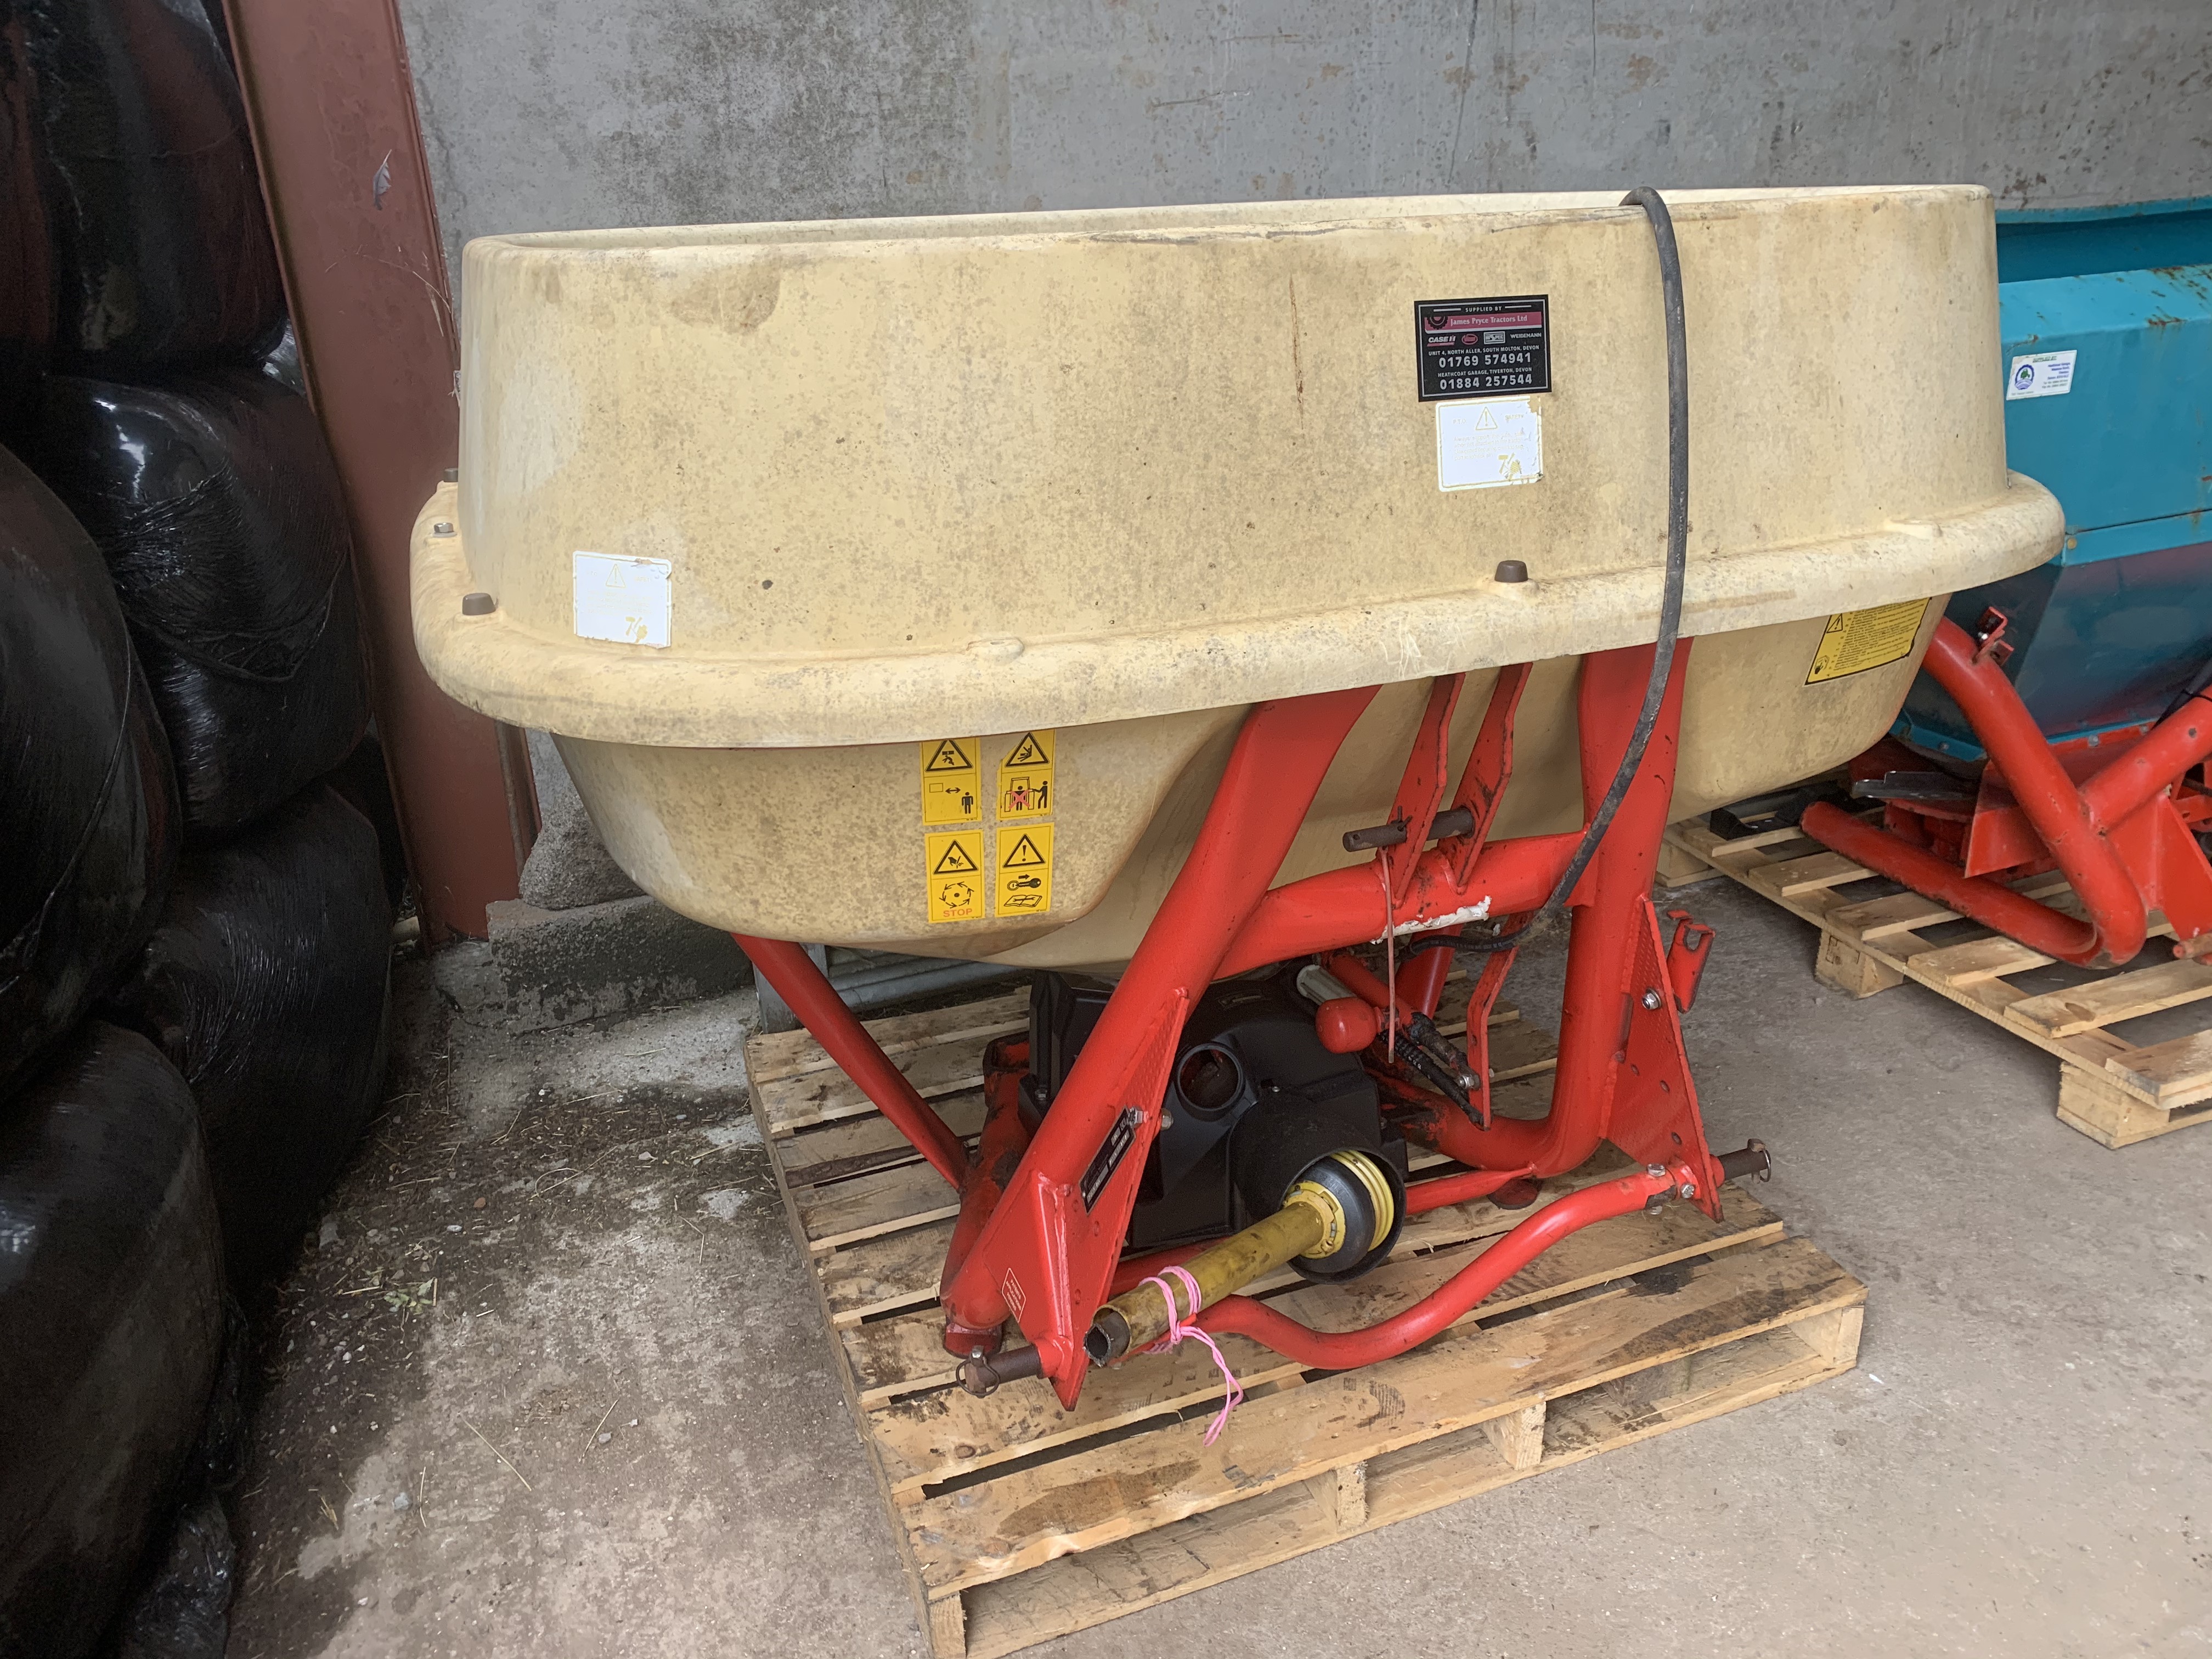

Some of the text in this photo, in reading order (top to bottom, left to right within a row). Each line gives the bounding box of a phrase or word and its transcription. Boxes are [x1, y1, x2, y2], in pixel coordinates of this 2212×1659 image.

[1451, 318, 1470, 326] James
[1439, 352, 1531, 368] 01769 574941
[1440, 374, 1532, 390] 01884 257544
[943, 908, 973, 918] STOP
